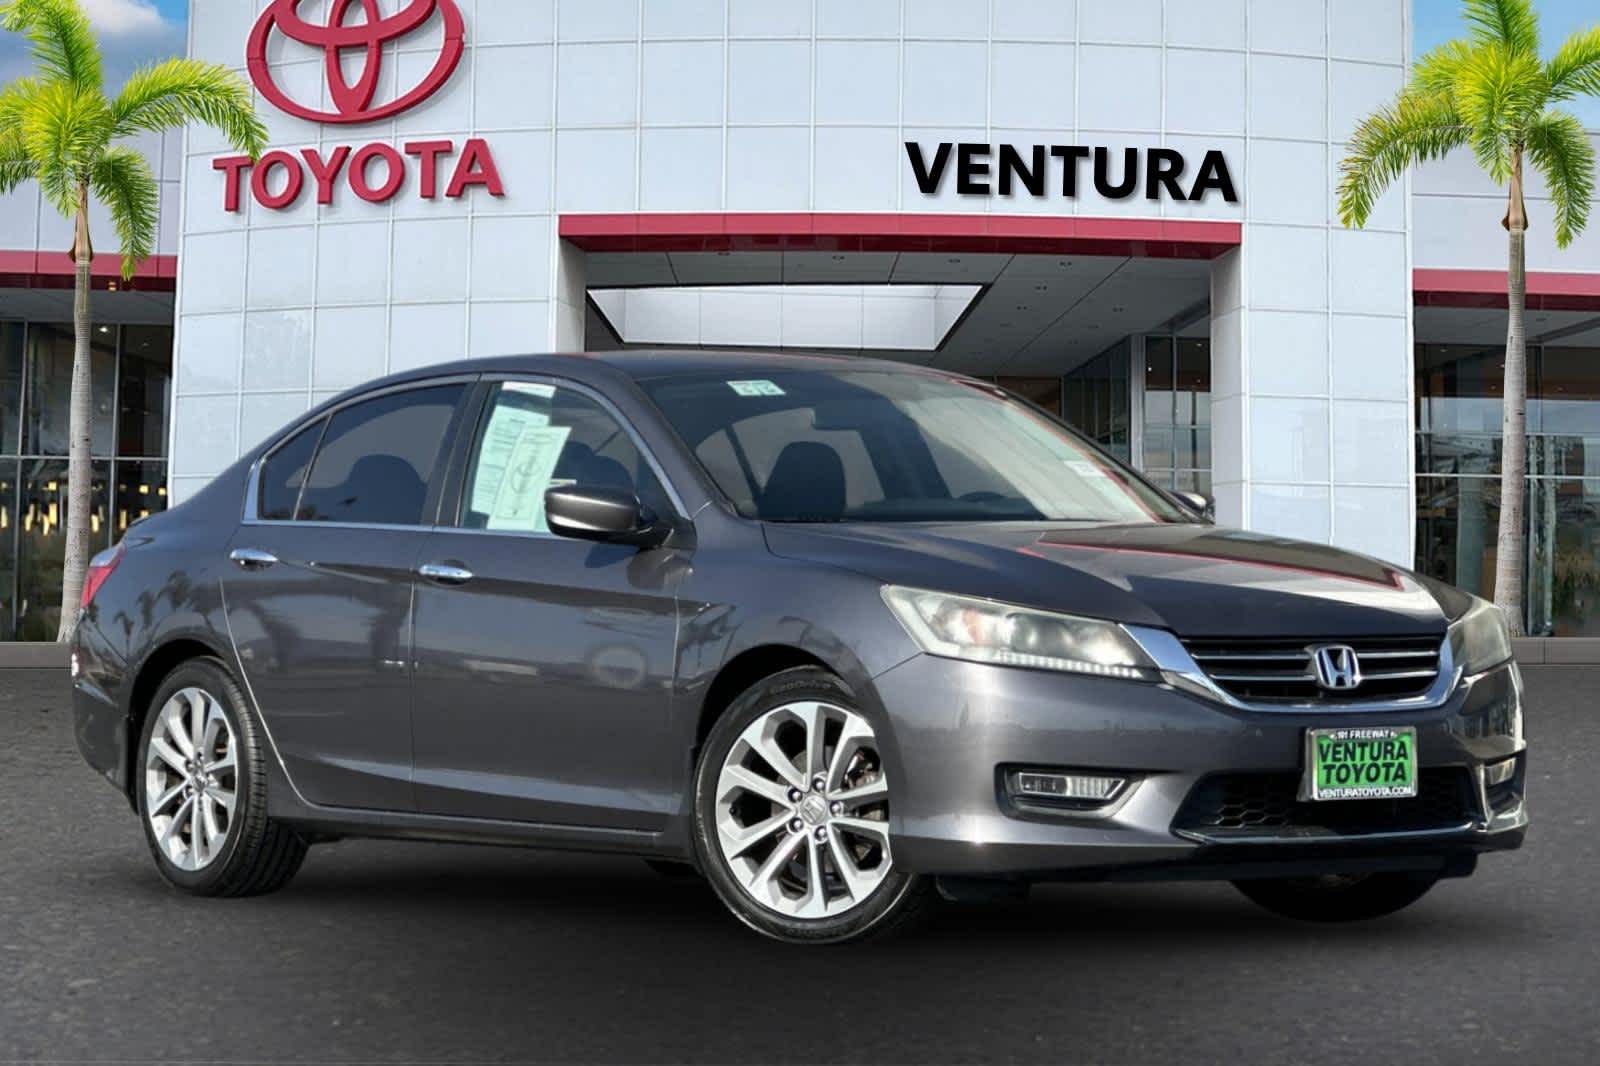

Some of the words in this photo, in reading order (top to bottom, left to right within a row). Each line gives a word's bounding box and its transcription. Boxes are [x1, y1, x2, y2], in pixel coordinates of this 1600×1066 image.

[212, 138, 505, 212] TOYOTA
[904, 141, 1238, 202] VENTURA
[1350, 729, 1389, 739] FREEWAY
[1319, 742, 1408, 762] VENTURA
[1323, 763, 1406, 784] TOYOTA
[1320, 787, 1411, 798] VENTURATOYOTA.COM
